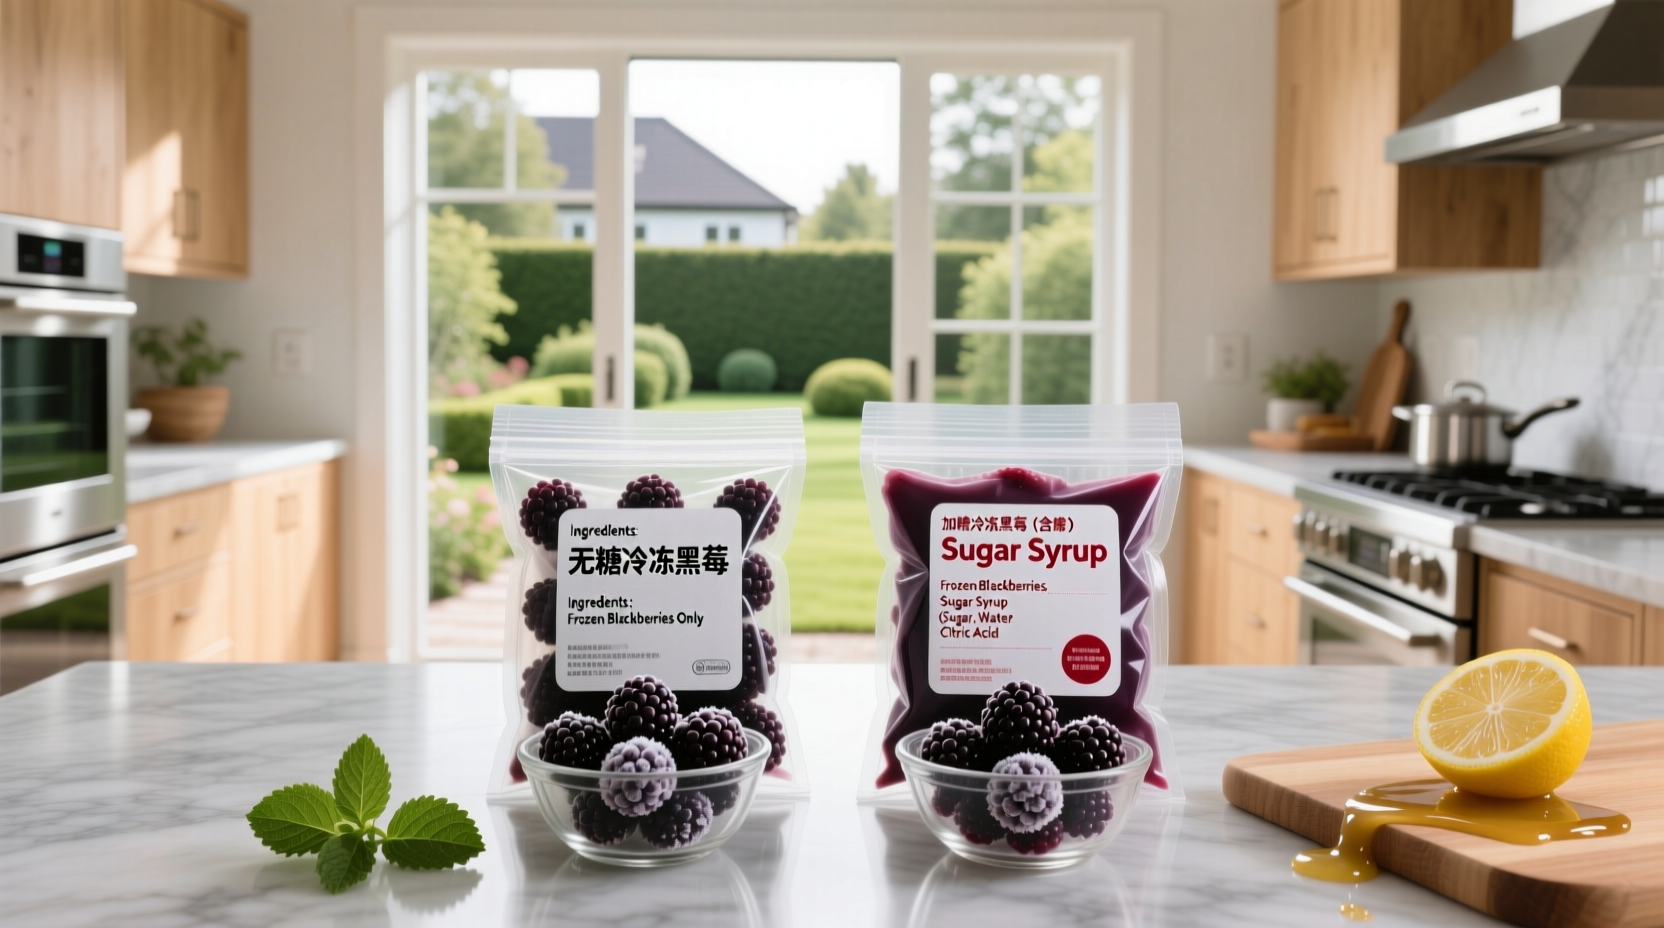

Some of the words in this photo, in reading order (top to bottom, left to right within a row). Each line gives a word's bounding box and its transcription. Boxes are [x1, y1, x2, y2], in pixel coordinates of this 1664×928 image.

[568, 544, 730, 576] 无糖冷冻黑莓
[941, 536, 1021, 568] Sugar
[1027, 537, 1108, 569] Syrup
[940, 579, 977, 591] Frozen
[940, 595, 973, 610] Sugar
[975, 596, 1008, 610] Syrup
[568, 612, 605, 625] Frozen
[676, 611, 705, 627] Only
[972, 626, 999, 638] Acid
